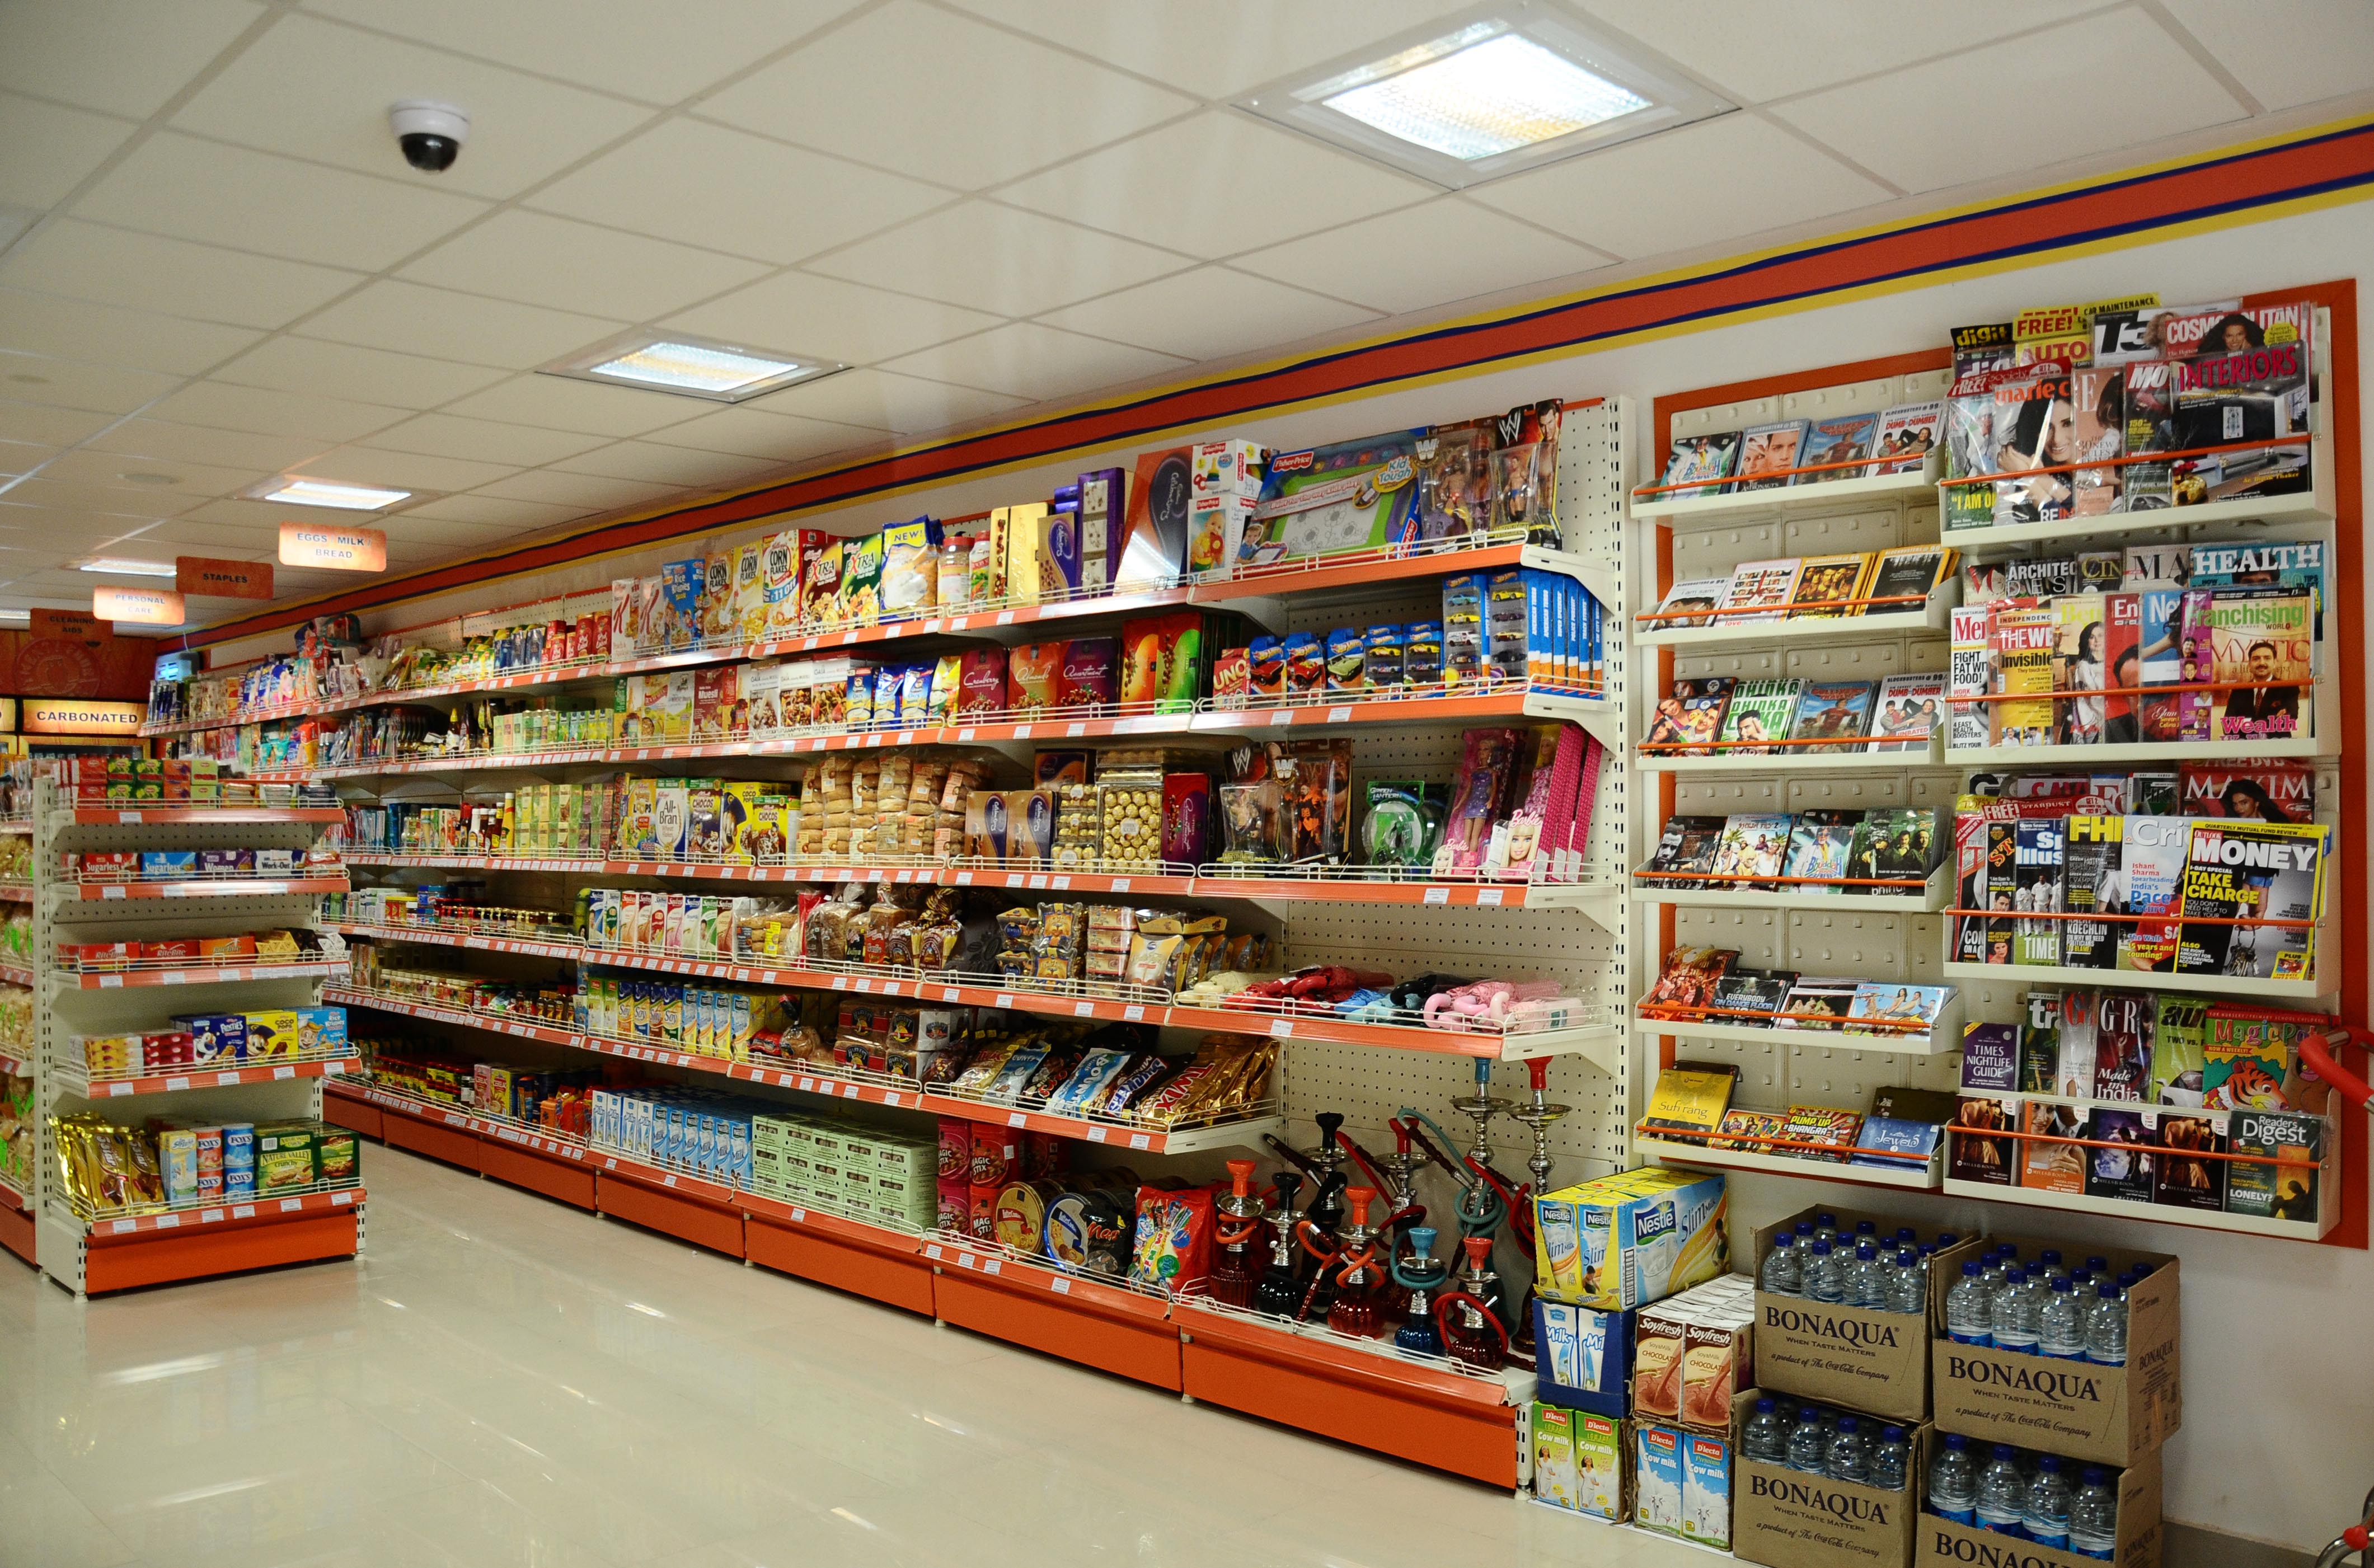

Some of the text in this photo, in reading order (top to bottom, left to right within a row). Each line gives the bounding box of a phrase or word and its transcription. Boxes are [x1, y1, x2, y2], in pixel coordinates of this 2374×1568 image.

[2084, 306, 2098, 315] CAR
[2099, 297, 2155, 313] MAINTENANCE
[2017, 316, 2073, 337] FREE!
[1957, 326, 2007, 346] digit
[2179, 345, 2297, 392] INTERIORS
[1886, 419, 1906, 430] DUMB
[1908, 414, 1937, 428] DUMBER
[1274, 454, 1312, 472] Fisher-Price
[1387, 458, 1409, 473] Kid
[1378, 468, 1413, 484] Tough
[297, 532, 327, 544] EGGS
[338, 536, 365, 546] MILK
[894, 529, 923, 541] NEW!
[316, 548, 353, 560] BREAD
[769, 547, 788, 566] CORN
[2194, 544, 2321, 575] HEALTH
[740, 554, 758, 572] CORN
[770, 562, 788, 575] FLAKES
[846, 554, 875, 575] EXTRA
[709, 562, 728, 579] CORN
[740, 571, 757, 581] FLAKES
[806, 559, 835, 583] EXTRA
[203, 572, 248, 584] STAPLES
[709, 576, 727, 586] FLAKES
[115, 594, 166, 605] PERSONAL
[128, 606, 153, 615] CARE
[2185, 602, 2303, 630] Franchising
[49, 615, 96, 625] CLEANING
[2266, 622, 2291, 631] WORLD
[62, 626, 83, 635] AIDS
[1954, 651, 1982, 663] FIGHT
[2001, 652, 2052, 669] Invisible
[1213, 658, 1247, 689] UNO
[1954, 673, 1982, 685] FOOD!
[698, 688, 720, 700] Muesli
[1887, 685, 1942, 698] DUMB DUMBER
[1732, 699, 1786, 712] DHINKA
[36, 711, 138, 724] CARBONATED
[2220, 715, 2298, 734] Wealth
[1897, 727, 1930, 736] UNRATED
[692, 798, 715, 809] CHOCOS
[659, 810, 678, 825] Bran
[758, 811, 778, 821] CHOCOS
[1984, 803, 2020, 820] FREE!
[1510, 809, 1542, 829] Barbie
[2194, 830, 2222, 839] OUTLOOK
[1444, 837, 1470, 852] Barbie
[2191, 837, 2317, 871] MONEY
[86, 862, 121, 873] Sugarless
[145, 862, 180, 873] Sugarless
[262, 861, 290, 870] Work-Out
[2131, 876, 2176, 885] Spearheading
[2189, 871, 2233, 888] TAKE
[2130, 890, 2172, 905] Pace
[2187, 885, 2259, 905] CHARGE
[2129, 904, 2166, 914] Future
[2185, 904, 2202, 913] NEED
[2067, 923, 2108, 936] KOECHLIN
[2127, 951, 2162, 960] counting!
[2136, 944, 2154, 954] years
[2159, 943, 2174, 952] and
[1714, 998, 1774, 1011] ON DANCE FLOOR
[1726, 993, 1766, 1003] EVERYBODY
[620, 1003, 632, 1016] Soy
[275, 1019, 295, 1027] COCO
[2166, 1035, 2185, 1045] TWO
[1974, 1045, 2004, 1056] TIMES
[1966, 1055, 2010, 1068] NIGHTLIFE
[1973, 1067, 2004, 1078] GUIDE
[2098, 1068, 2132, 1082] Made
[1153, 1062, 1215, 1112] TWIX
[2096, 1083, 2141, 1103] India
[1658, 1100, 1709, 1120] Sufi rang
[1790, 1115, 1831, 1127] PUMP UP
[1787, 1124, 1828, 1136] BHANGRA
[2242, 1119, 2307, 1146] Digest
[262, 1150, 311, 1165] NATURE VALLEY
[275, 1160, 298, 1170] crunchy
[2229, 1189, 2273, 1203] LONELY?
[1639, 1318, 1681, 1336] Soyfresh
[1765, 1306, 1899, 1349] BONAQUA
[1686, 1327, 1731, 1345] Soyfresh
[1786, 1336, 1876, 1357] WHEN TASTE MATTERS
[1642, 1349, 1676, 1363] CHOCOLATE
[1689, 1359, 1725, 1373] CHOCOLATE
[1775, 1354, 1801, 1365] product
[1801, 1359, 1810, 1368] of
[1811, 1358, 1824, 1368] The
[1855, 1366, 1890, 1382] Company
[1948, 1356, 2100, 1402] BONAQUA
[1973, 1388, 2075, 1412] WHEN TASTE MATTERS
[1537, 1431, 1570, 1447] Cow milk
[1580, 1440, 1613, 1455] Cow milk
[1643, 1452, 1677, 1469] Cow milk
[1688, 1463, 1725, 1480] Cow milk
[1750, 1475, 1888, 1525] BONAQUA
[1774, 1505, 1866, 1532] WHEN TASTE MATTERS
